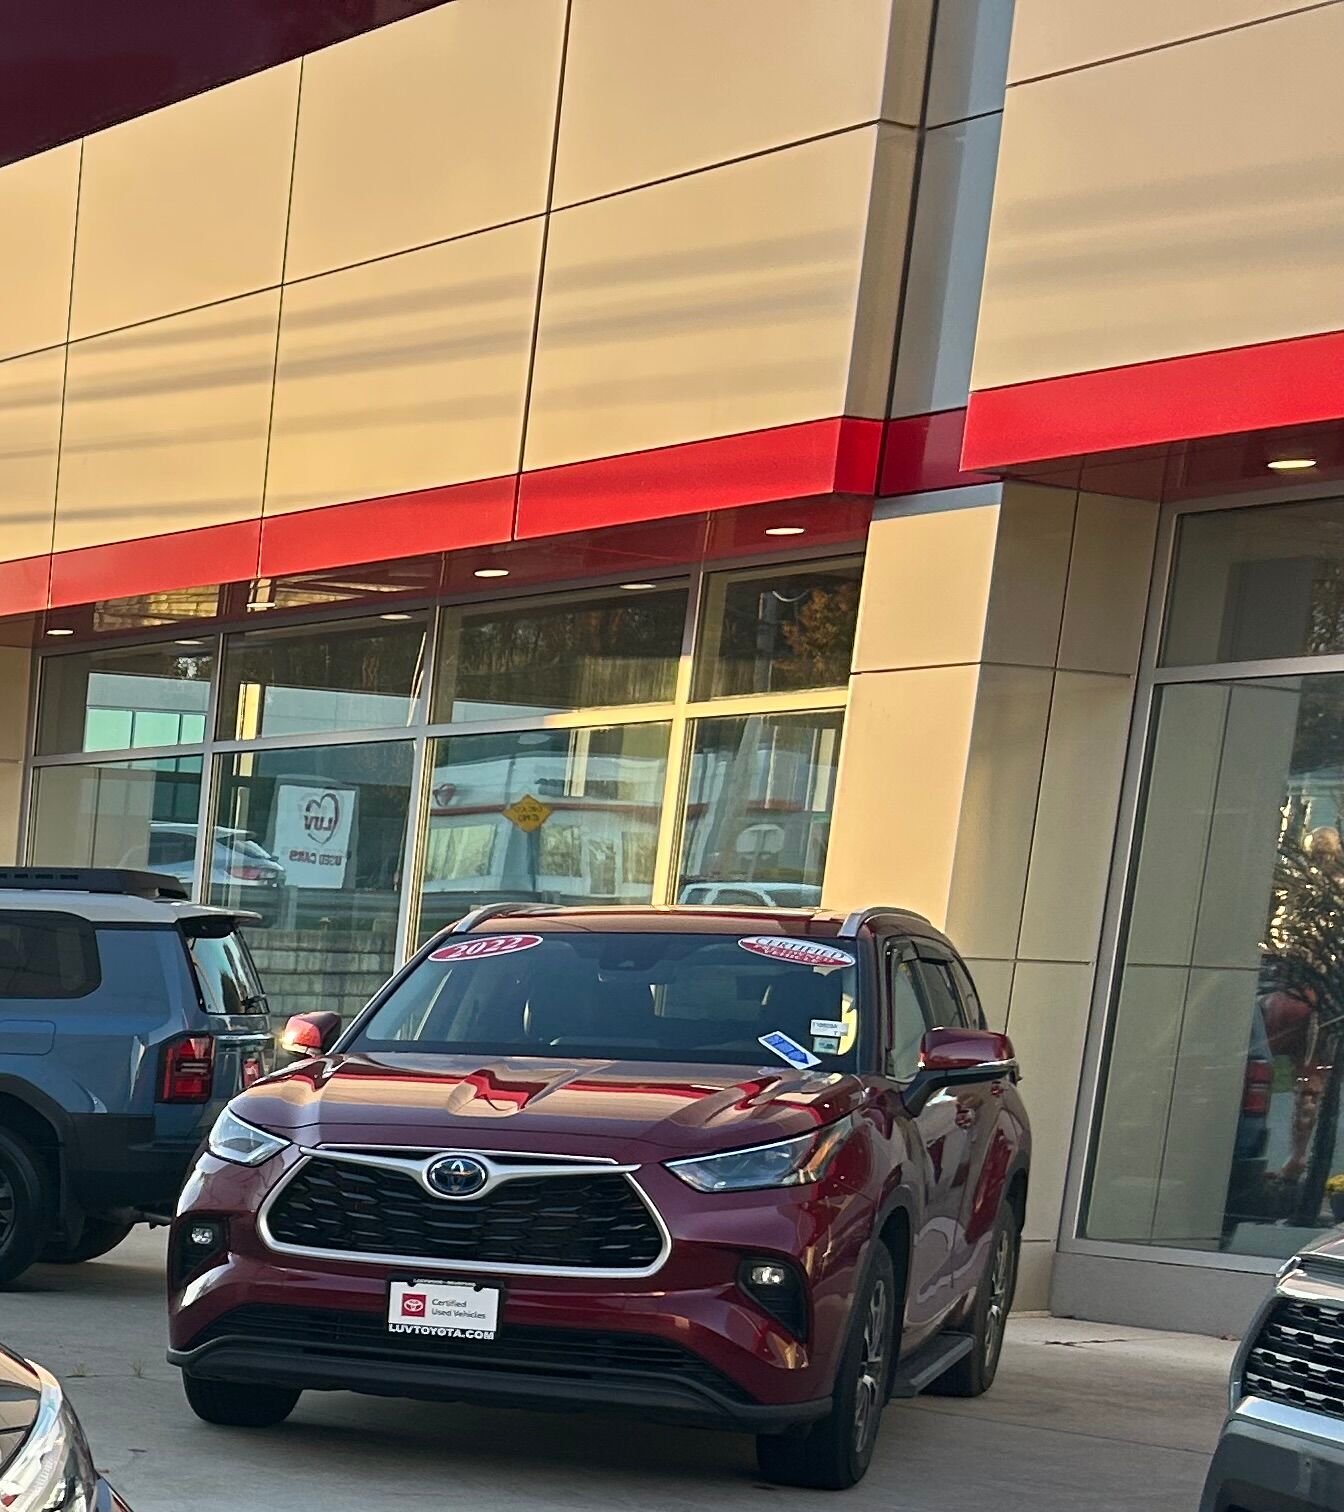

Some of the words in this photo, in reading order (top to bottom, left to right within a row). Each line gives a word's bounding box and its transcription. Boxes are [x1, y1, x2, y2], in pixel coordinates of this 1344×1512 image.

[446, 937, 523, 959] 2022
[432, 1298, 467, 1308] Certified
[432, 1309, 452, 1317] Used
[454, 1309, 486, 1320] Vehicles
[388, 1323, 494, 1340] LUVTOYOTA.COM
